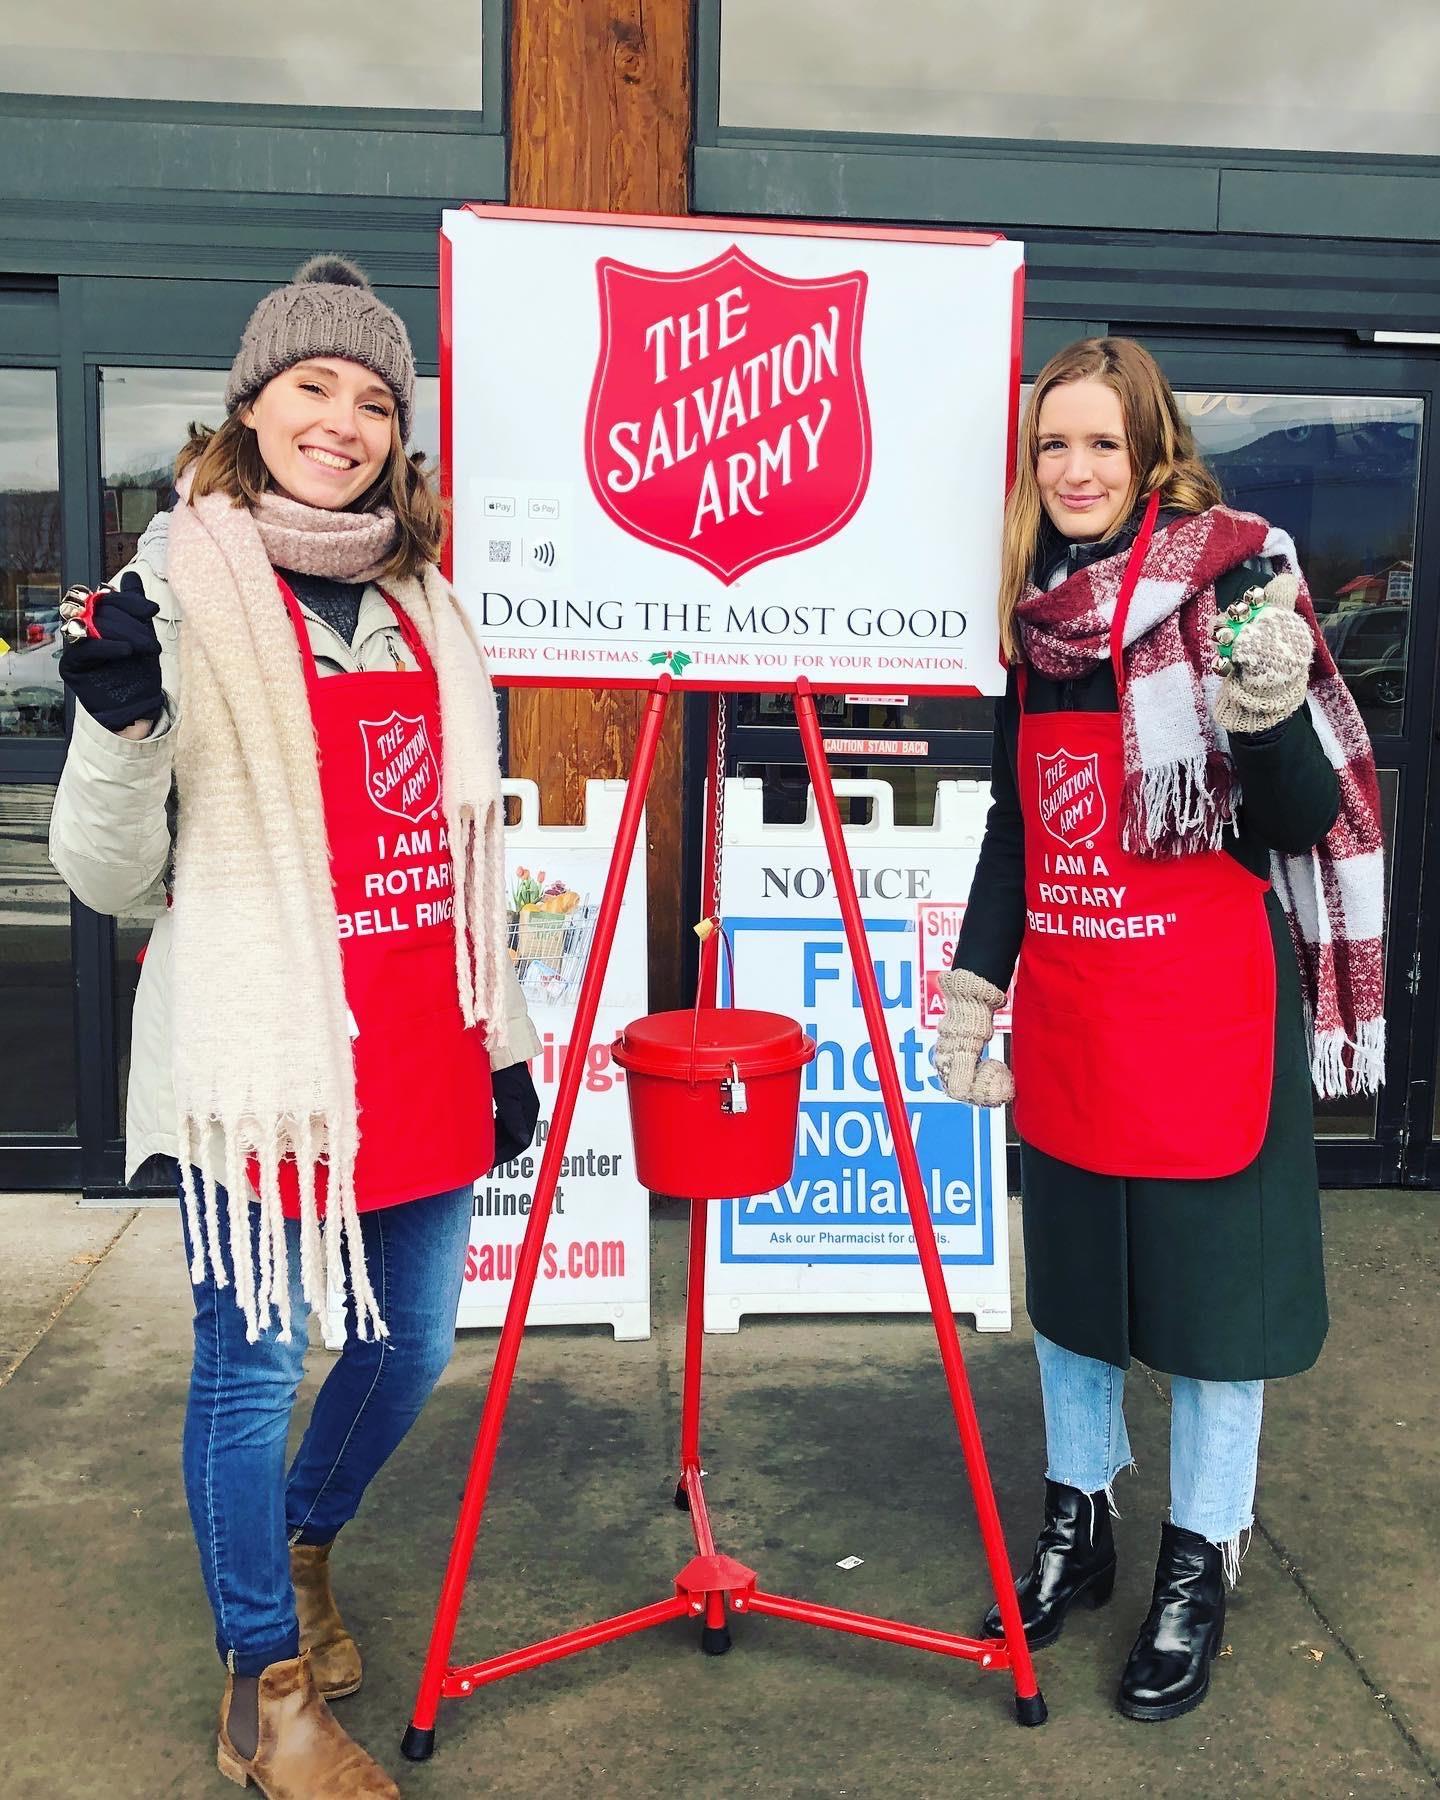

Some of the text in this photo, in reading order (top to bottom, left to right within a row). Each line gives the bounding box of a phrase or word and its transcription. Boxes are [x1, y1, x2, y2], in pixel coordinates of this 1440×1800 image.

[644, 286, 750, 385] THE
[606, 306, 841, 494] SALVATION
[689, 399, 833, 540] ARMY
[495, 502, 512, 512] Pay
[541, 504, 556, 514] Pay
[480, 592, 967, 639] DOING THE MOST GOOD
[482, 645, 968, 671] MERRY CHRISTMAS. THANK YOU FOR YOUR DONATION.
[377, 722, 405, 760] THE
[824, 740, 927, 755] CAUTION STAND BACK
[372, 724, 428, 799] SALVATION
[1045, 758, 1068, 790] THE
[402, 756, 432, 812] ARMY
[1042, 762, 1095, 822] SALVATION
[1060, 791, 1095, 837] ARMY
[377, 836, 386, 860] I
[393, 830, 433, 858] AM
[1044, 853, 1110, 877] I AM A
[761, 867, 932, 900] NOICE
[1038, 883, 1127, 909] ROTARY
[1072, 913, 1177, 940] RINGER"
[559, 1148, 622, 1178] enter
[472, 1186, 532, 1217] nline
[769, 1231, 792, 1244] Ask
[796, 1234, 816, 1244] our
[819, 1231, 885, 1245] Pharmacist
[888, 1231, 904, 1244] for
[464, 1240, 625, 1282] saus.com
